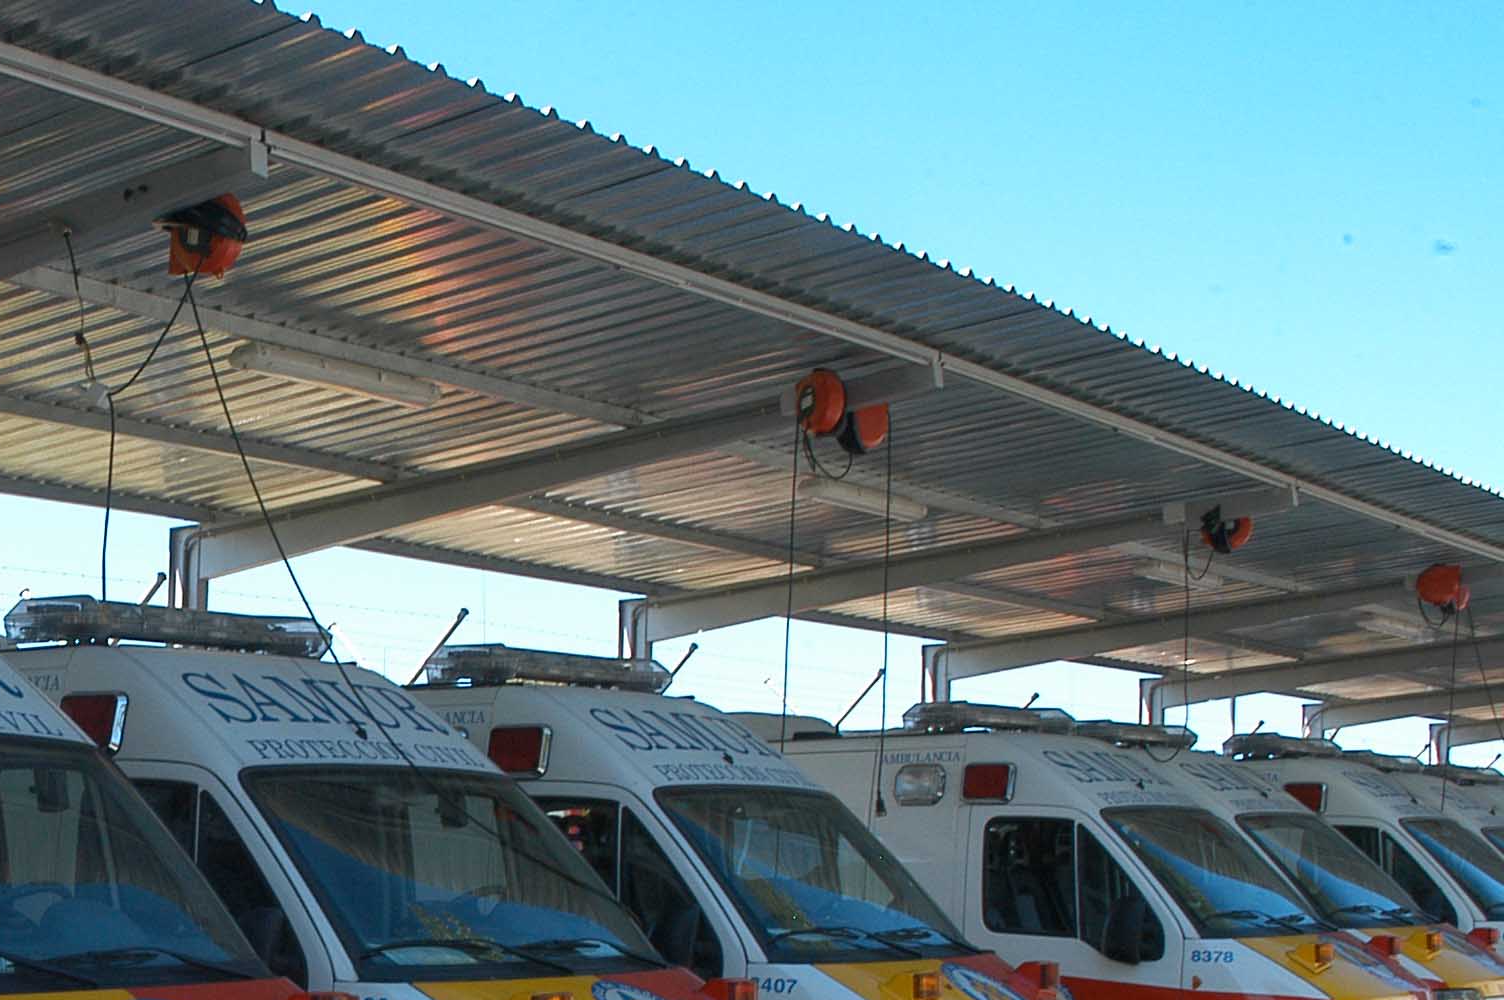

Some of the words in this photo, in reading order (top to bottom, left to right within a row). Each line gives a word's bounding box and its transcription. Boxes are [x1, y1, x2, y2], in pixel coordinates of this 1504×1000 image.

[182, 672, 449, 735] SAMUR
[414, 743, 485, 768] CIVIL
[1191, 950, 1234, 963] 8378
